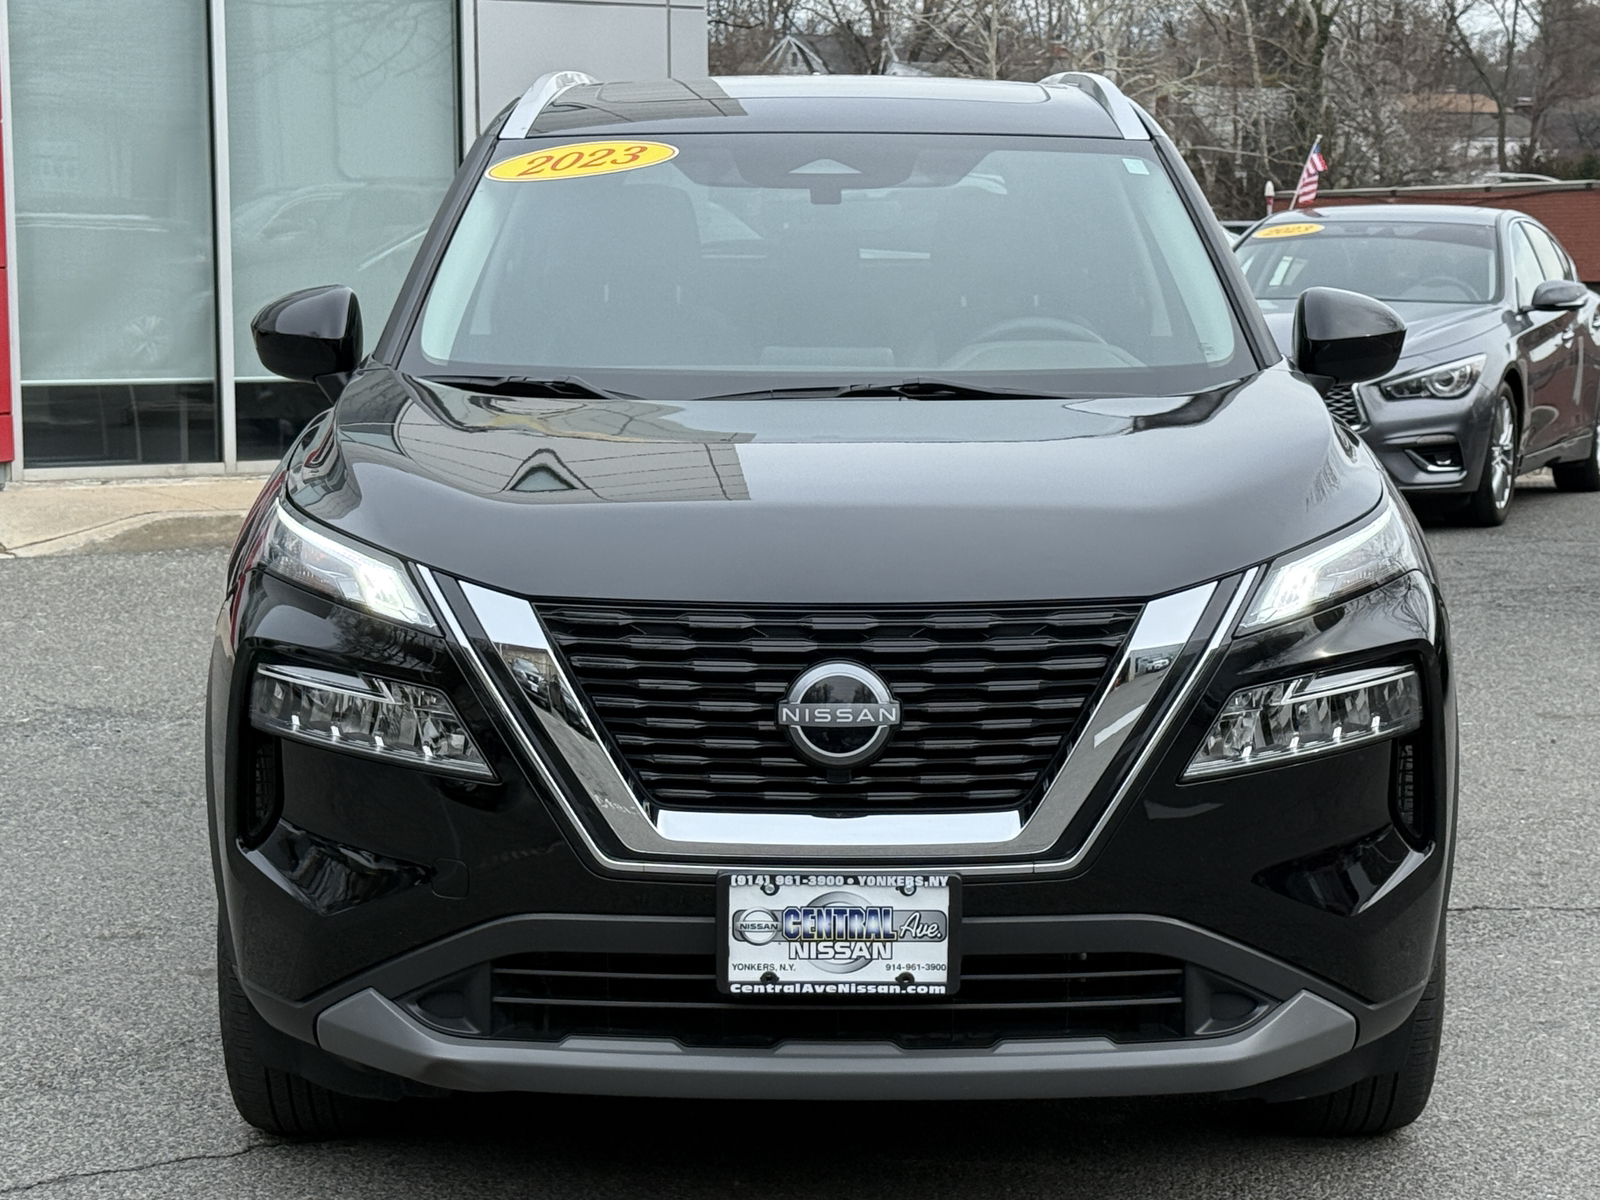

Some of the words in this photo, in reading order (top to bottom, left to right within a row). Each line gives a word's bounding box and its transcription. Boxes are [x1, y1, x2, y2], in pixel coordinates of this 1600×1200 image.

[516, 145, 648, 177] 2023
[782, 707, 896, 722] NISSAN
[730, 874, 770, 886] (914)
[775, 874, 844, 886] 961-3900
[782, 906, 898, 941] CENTRAL
[899, 910, 943, 939] Ave.
[788, 941, 893, 960] NISSAN
[731, 963, 778, 972] YONKERS,
[779, 963, 796, 972] N.Y.
[885, 963, 947, 972] 914-961-3900
[729, 983, 946, 994] CentralAveNissan.com
